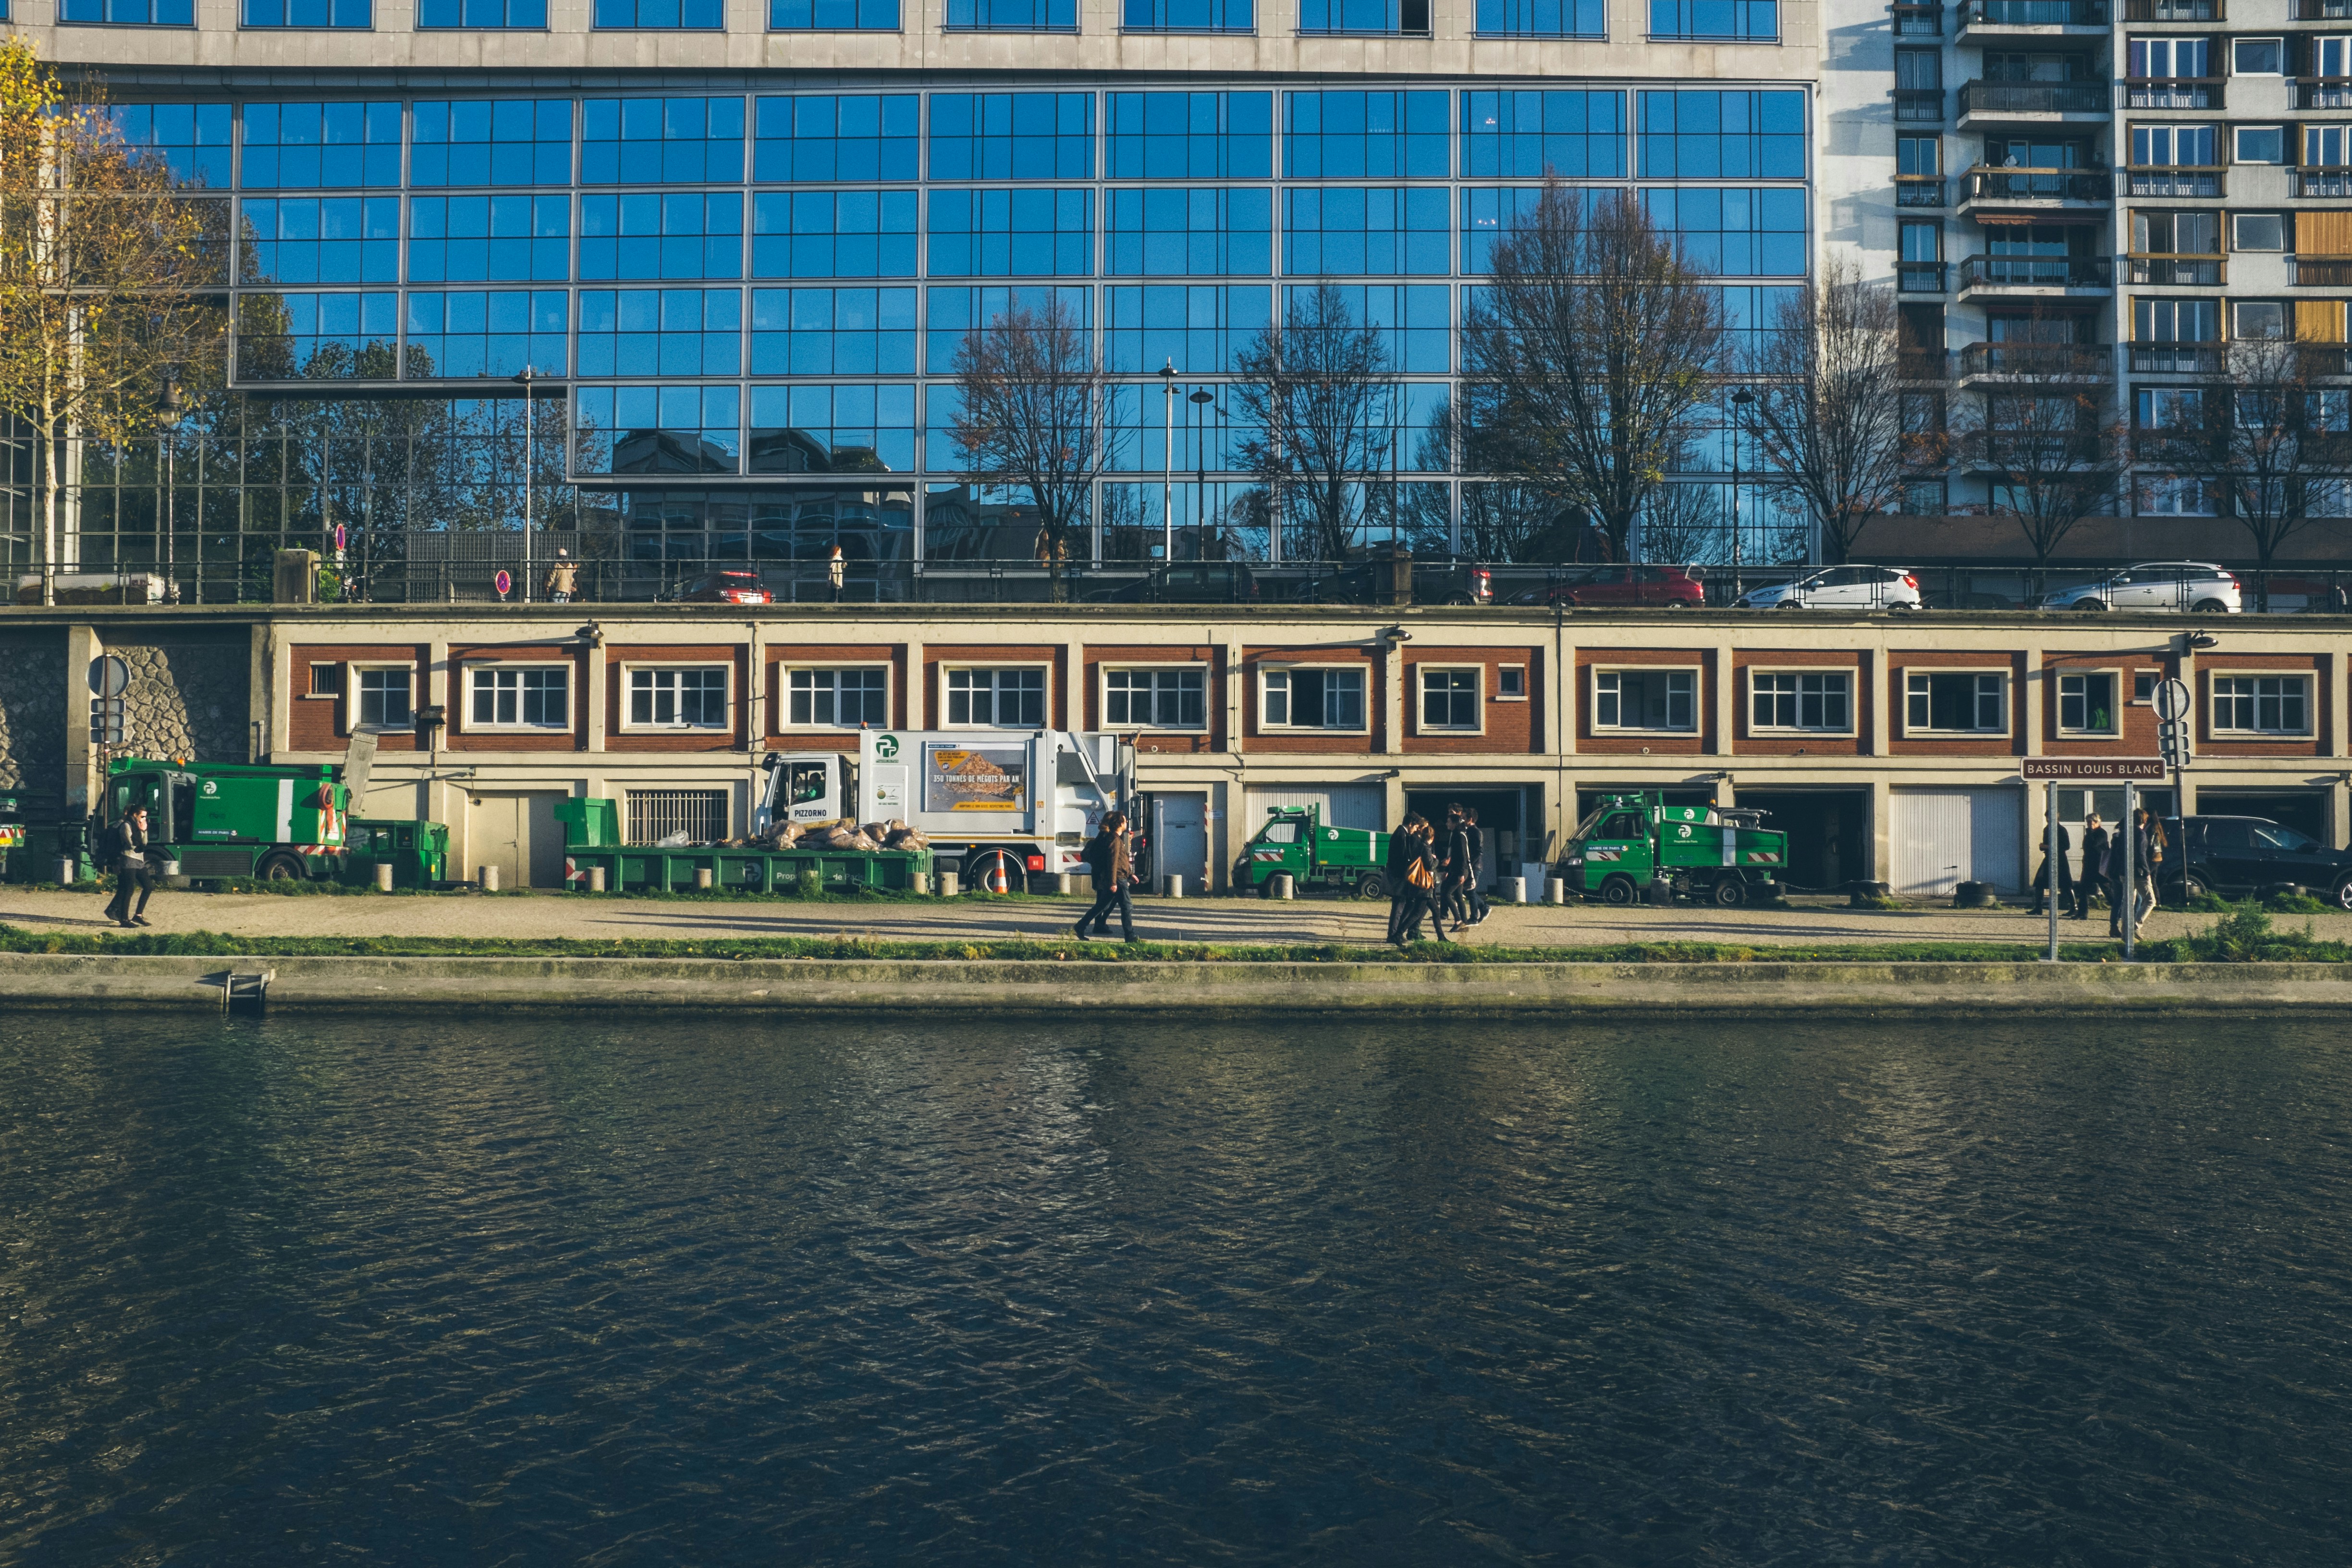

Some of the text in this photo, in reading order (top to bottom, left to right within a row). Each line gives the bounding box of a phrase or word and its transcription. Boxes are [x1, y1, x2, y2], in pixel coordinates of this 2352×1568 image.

[2027, 765, 2160, 774] BASSIN LOUIS BLANC
[977, 774, 998, 783] MÉGOTS
